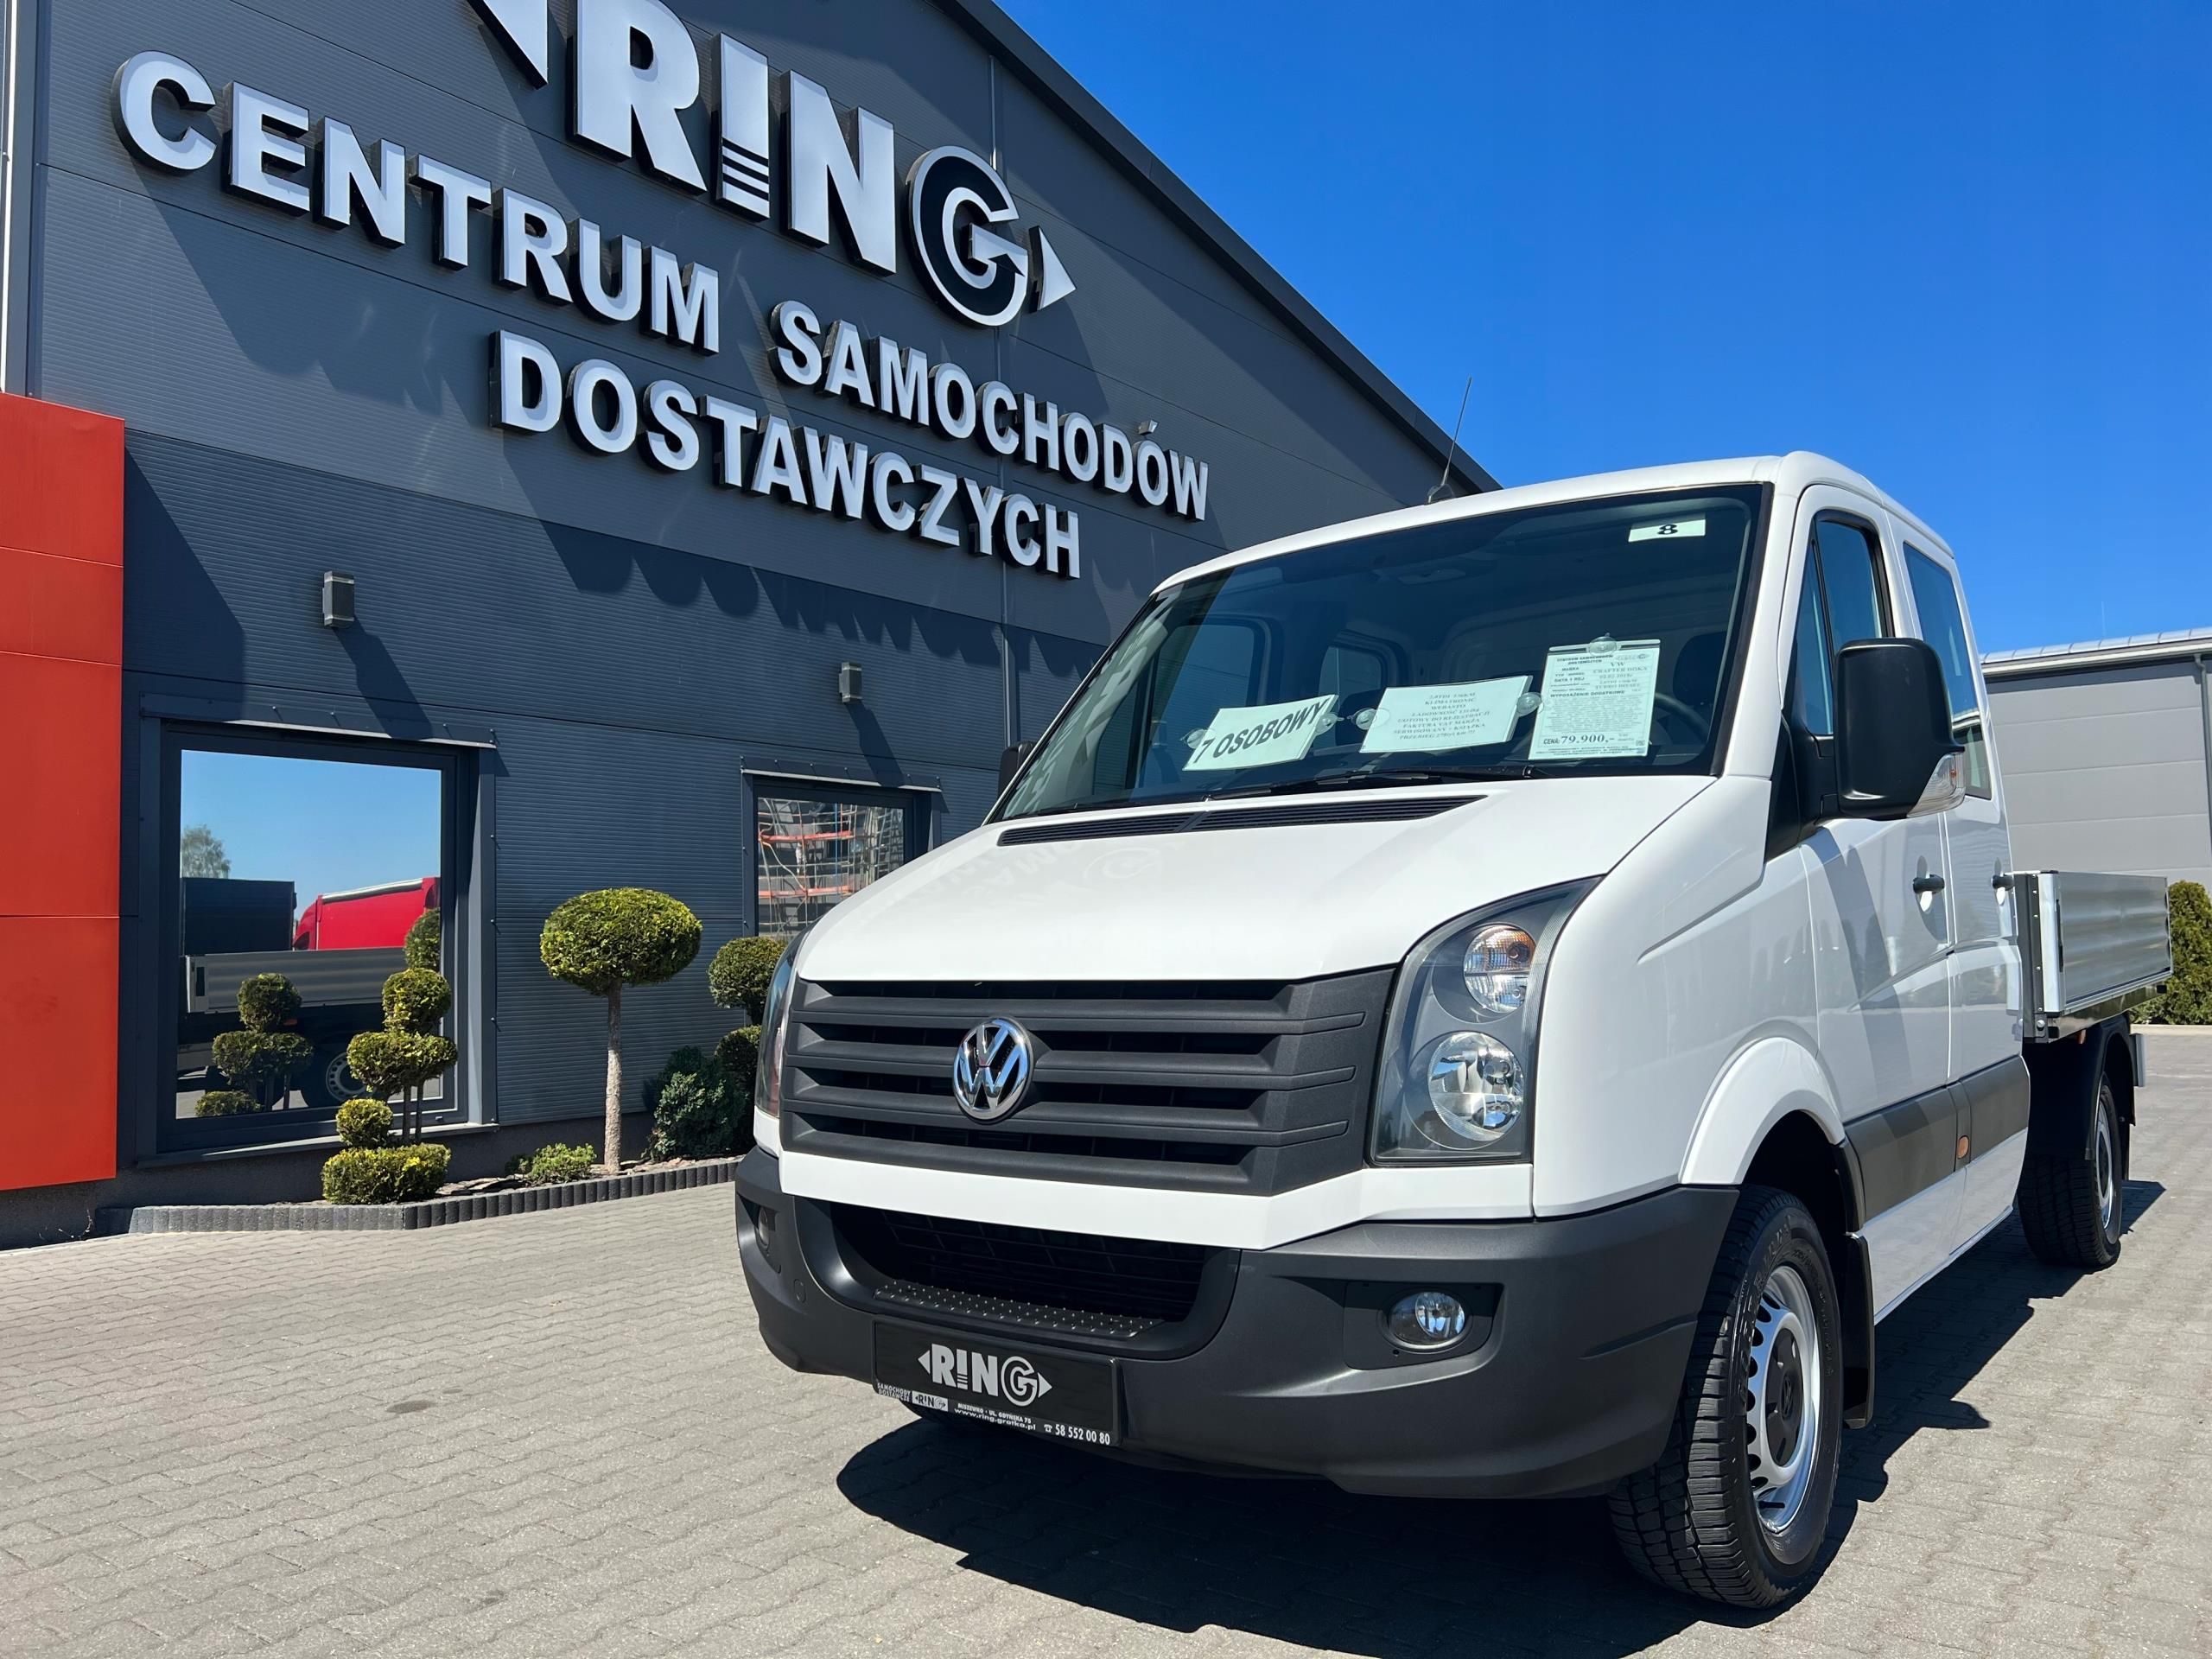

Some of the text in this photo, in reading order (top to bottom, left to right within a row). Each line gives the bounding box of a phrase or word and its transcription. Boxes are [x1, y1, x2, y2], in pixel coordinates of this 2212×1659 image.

[574, 0, 1029, 327] RING
[115, 50, 1209, 522] CENTRUM SAMOCHODÓW
[493, 329, 1081, 580] DOSTAWCZYCH
[1657, 524, 1679, 535] 8
[1193, 697, 1331, 764] 7 OSOBOWY
[931, 1343, 1038, 1407] RING
[1055, 1423, 1110, 1446] 58 552 00 80
